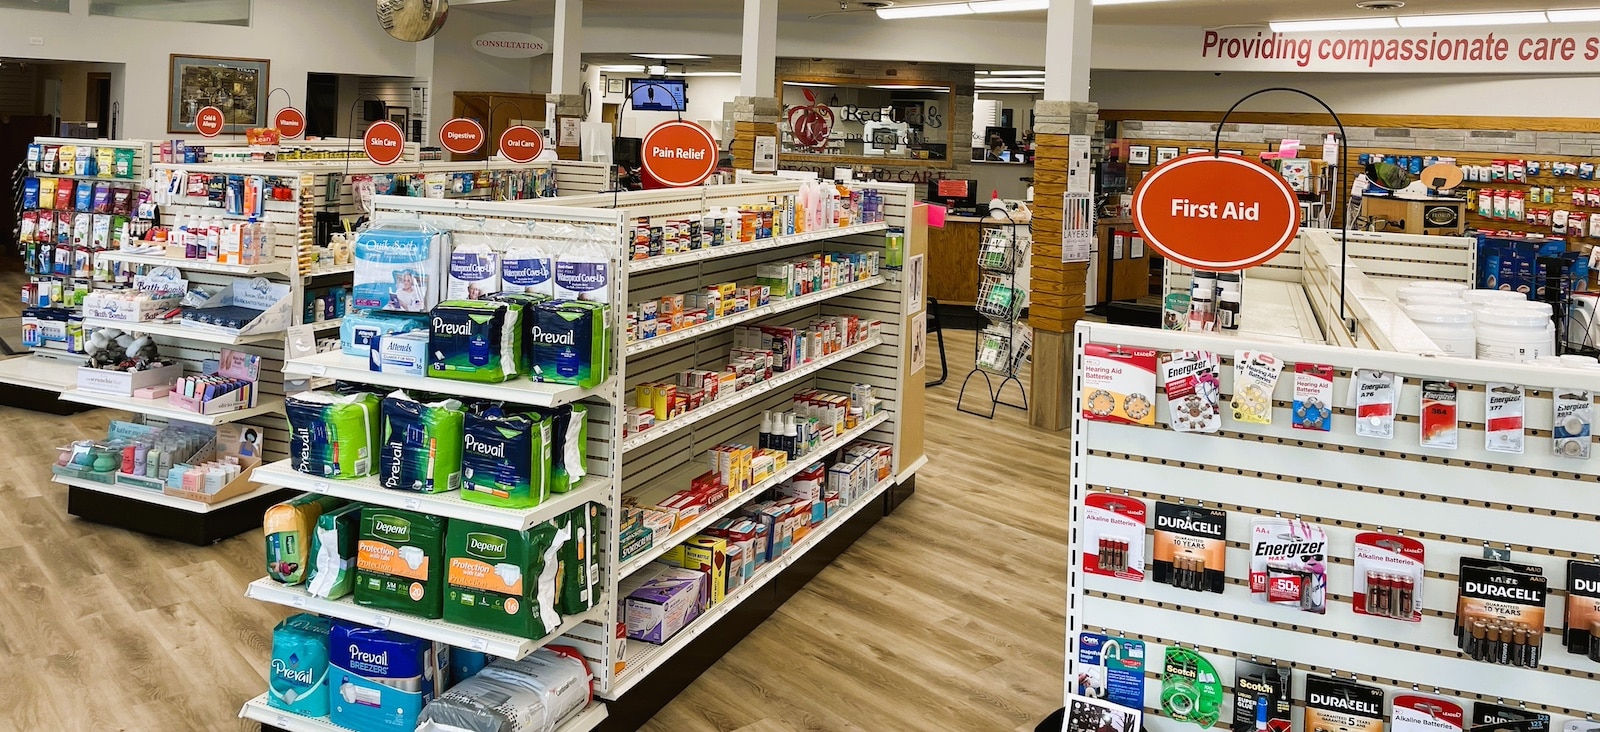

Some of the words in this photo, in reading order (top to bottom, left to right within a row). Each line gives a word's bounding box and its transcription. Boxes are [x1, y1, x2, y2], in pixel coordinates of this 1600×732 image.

[476, 39, 544, 50] CONSULTATION
[1202, 30, 1312, 67] Providing
[1318, 31, 1509, 68] compassionate
[1518, 37, 1576, 61] care
[202, 121, 217, 129] Allergy
[280, 119, 299, 127] Vitamins
[370, 137, 383, 146] Skin
[384, 138, 397, 147] Care
[447, 131, 476, 141] Digestive
[507, 139, 520, 147] Oral
[521, 140, 534, 148] Care
[652, 146, 674, 159] Pain
[676, 147, 705, 160] Relief
[1170, 198, 1218, 218] First
[1222, 199, 1260, 221] Aid
[1063, 230, 1089, 239] LAYERS
[432, 316, 472, 336] Prevail
[531, 325, 575, 346] Prevail
[386, 341, 412, 352] Attends
[1085, 365, 1110, 374] Hearing
[1111, 367, 1123, 375] Aid
[1085, 372, 1113, 381] Batteries
[1168, 360, 1206, 379] Energizer
[1246, 364, 1267, 377] Hearing
[1267, 371, 1277, 380] Aid
[1249, 370, 1272, 384] Batteries
[1296, 381, 1317, 389] Hearing
[1296, 386, 1321, 394] Batteries
[1361, 382, 1391, 391] Energizer
[1423, 392, 1455, 400] Energizer
[1489, 395, 1522, 404] Energizer
[1557, 402, 1590, 412] Energizer
[298, 427, 309, 474] Prevail
[464, 433, 505, 458] Prevail
[386, 441, 403, 488] Prevail
[375, 520, 407, 535] Depend
[1086, 514, 1110, 523] Alkaline
[1110, 517, 1137, 528] Batteries
[1158, 515, 1221, 536] DURACELL
[359, 542, 394, 556] Protection
[470, 538, 504, 553] Depend
[1182, 541, 1206, 550] YEARS
[1255, 541, 1325, 559] Energizer
[1357, 552, 1384, 562] Alkaline
[1385, 556, 1415, 566] Batteries
[452, 559, 490, 574] Protection
[1252, 574, 1265, 584] 10
[1277, 579, 1300, 592] 50%
[1465, 581, 1541, 602] DURACELL
[507, 602, 516, 610] 16
[1485, 602, 1520, 610] GUARANTEED
[1494, 606, 1521, 616] YEARS
[349, 644, 388, 666] Prevail
[271, 658, 314, 685] Prevail
[349, 660, 388, 675] BREEZERS
[1166, 664, 1196, 678] Scotch
[1239, 678, 1273, 694] Scotch
[1237, 697, 1257, 706] SUPER
[1237, 702, 1254, 710] GLUE
[1310, 693, 1379, 714] DURACELL
[1316, 712, 1348, 720] GUARANTEED
[1348, 717, 1355, 726] 5
[1395, 714, 1422, 724] Alkaline
[1422, 720, 1453, 730] Batteries
